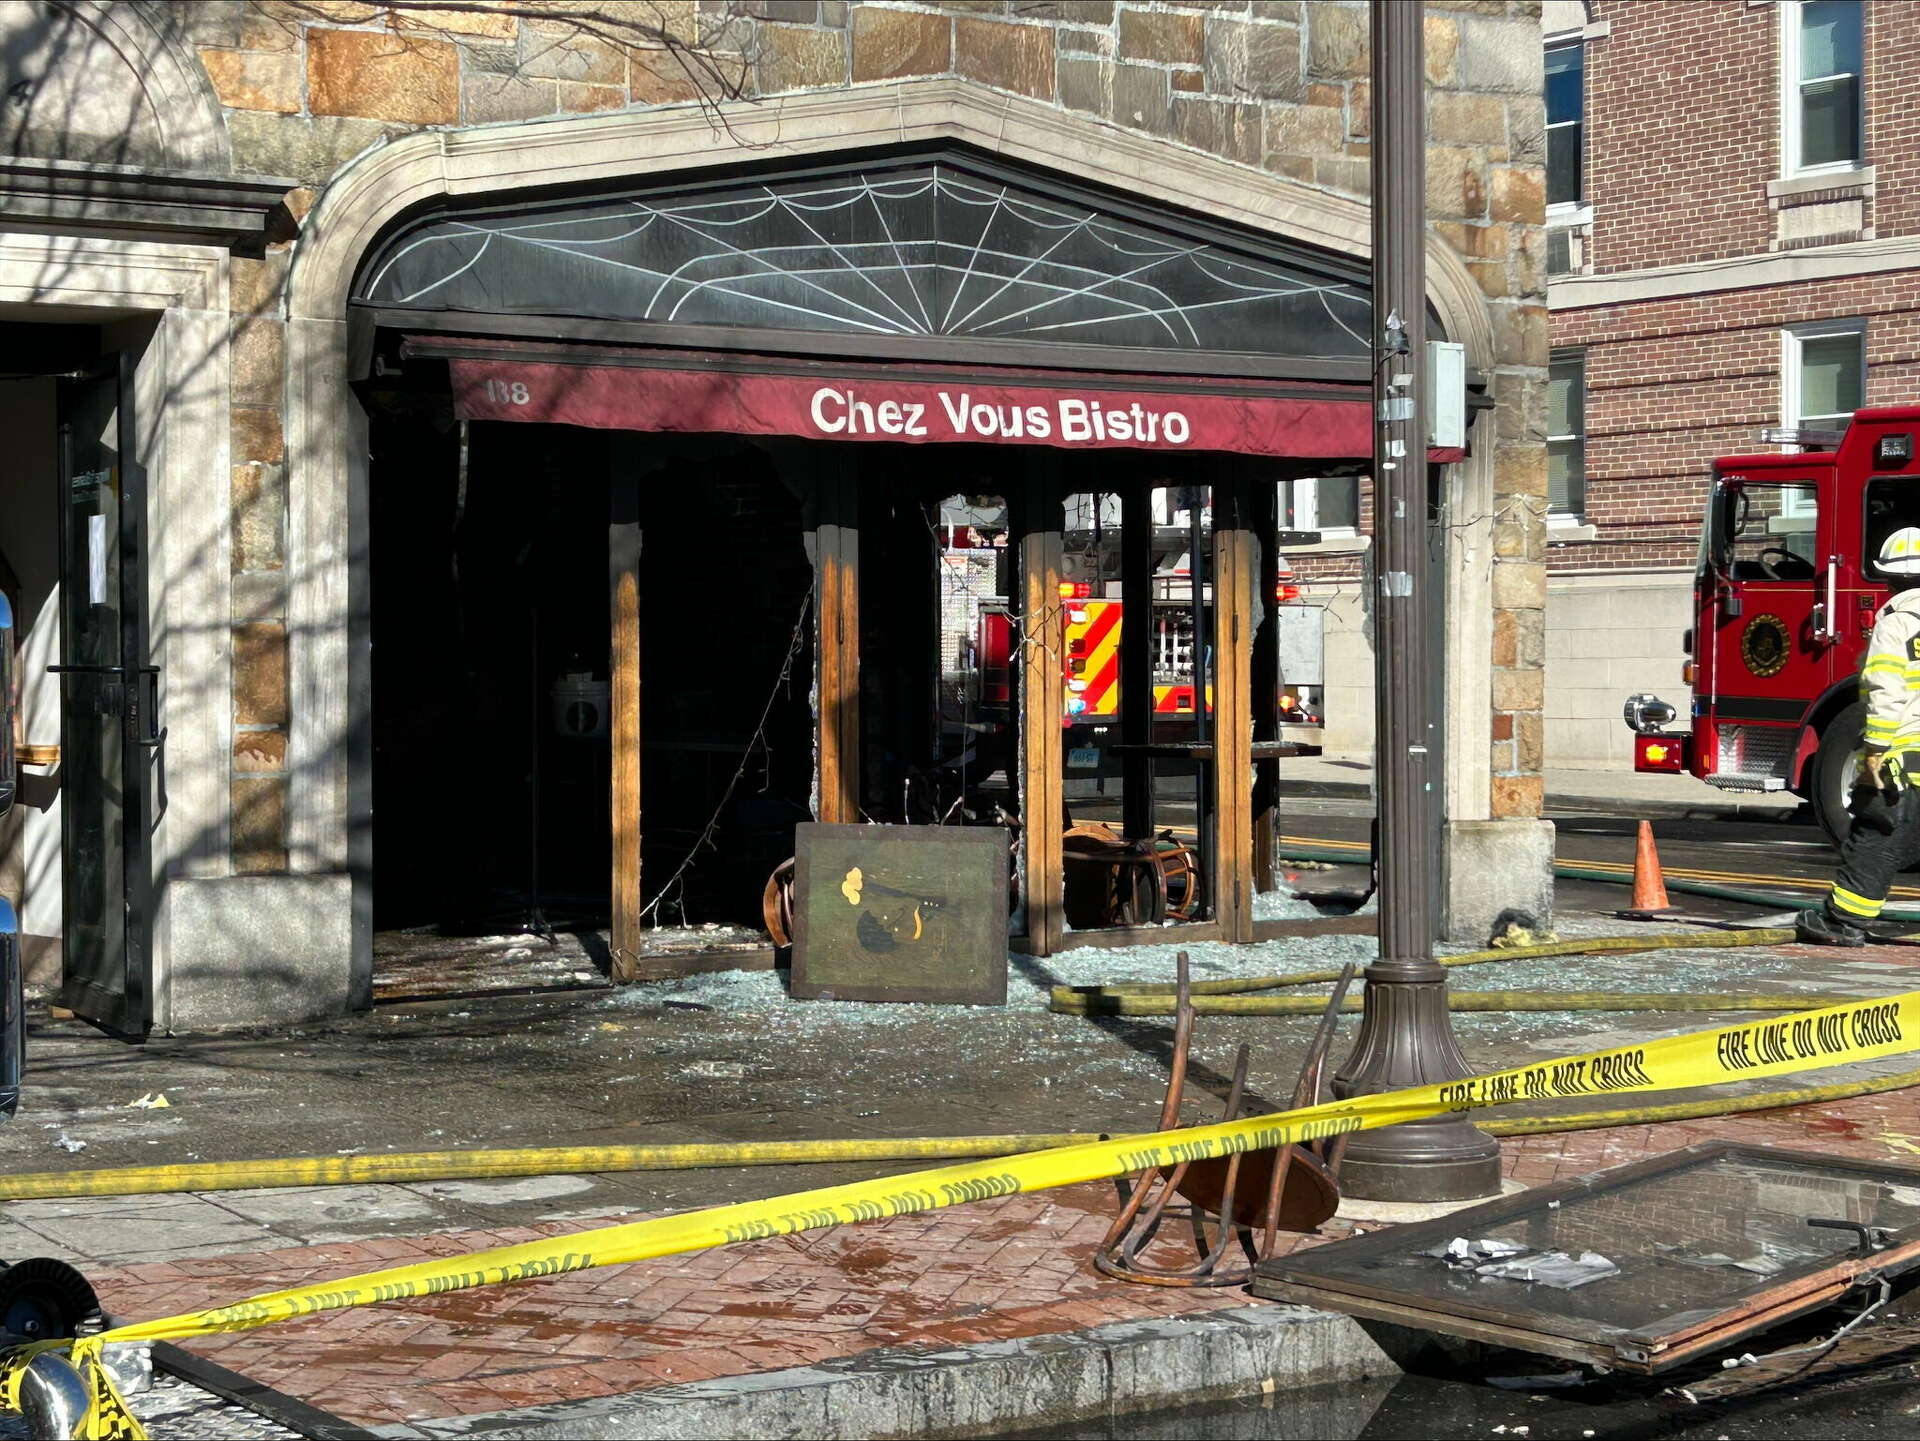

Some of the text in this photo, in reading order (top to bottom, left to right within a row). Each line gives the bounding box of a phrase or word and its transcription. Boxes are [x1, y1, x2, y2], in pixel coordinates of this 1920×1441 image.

[811, 387, 1190, 444] Chez Vous Bistro
[1717, 1002, 1902, 1071] FIRE LINE DO NOT CROSS
[1523, 1067, 1552, 1098] DO
[1551, 1061, 1593, 1096] NOT
[1591, 1049, 1655, 1091] CROSS
